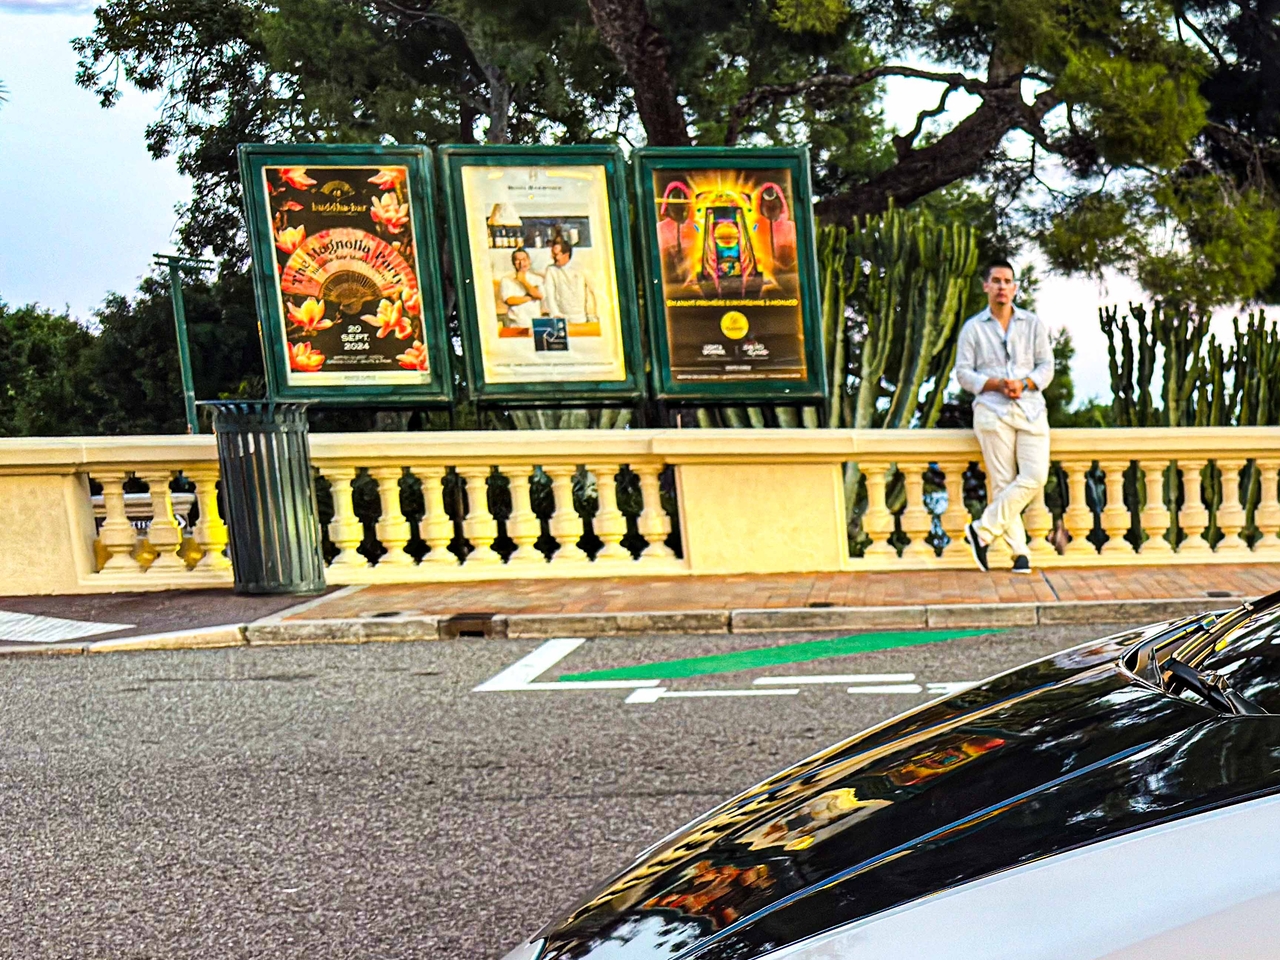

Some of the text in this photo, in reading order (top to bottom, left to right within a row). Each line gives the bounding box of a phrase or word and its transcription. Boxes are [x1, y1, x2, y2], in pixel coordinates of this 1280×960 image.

[306, 239, 371, 262] Magnolia
[347, 324, 362, 333] 20
[344, 342, 370, 350] 2024
